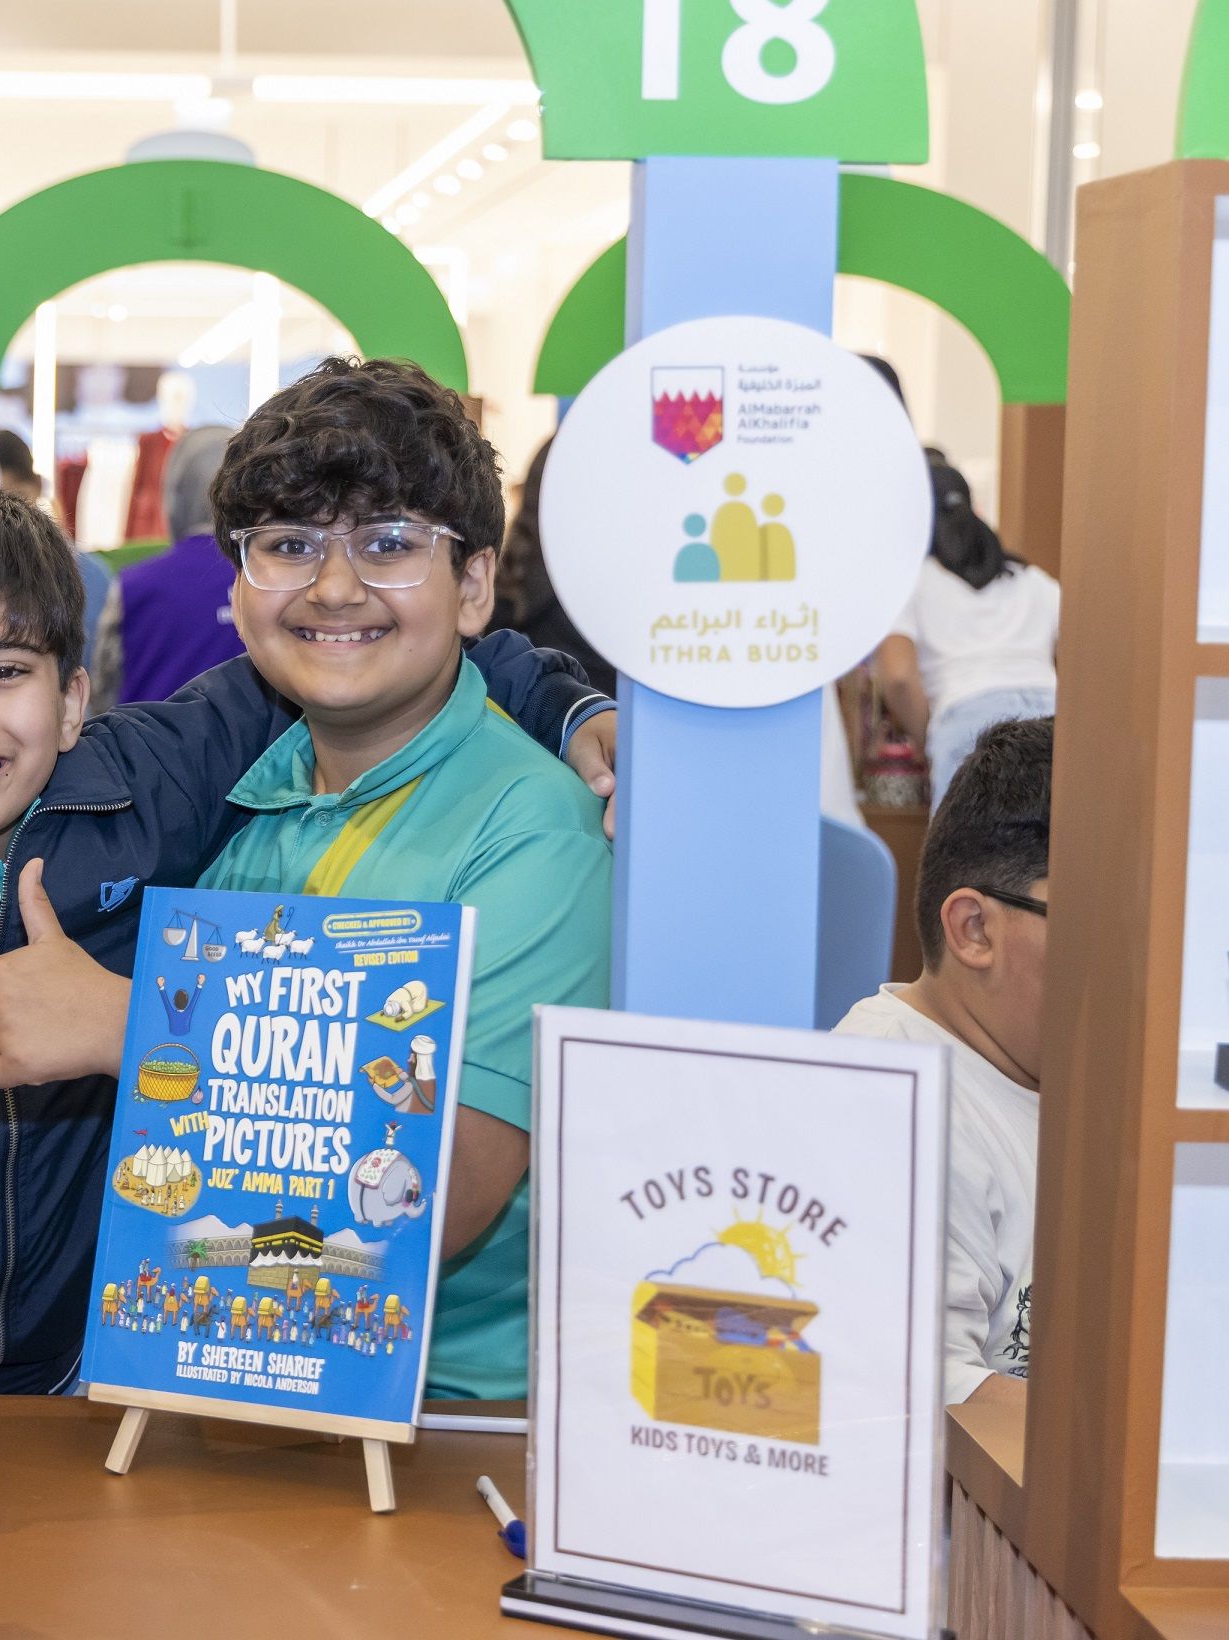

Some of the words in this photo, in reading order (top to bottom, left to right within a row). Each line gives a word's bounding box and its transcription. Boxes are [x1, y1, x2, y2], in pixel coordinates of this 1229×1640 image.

[641, 0, 836, 104] 18
[738, 403, 821, 415] AlMabarrah
[737, 434, 793, 444] Foundation
[650, 608, 741, 639] البراعم
[650, 643, 731, 663] ITHRA
[748, 643, 820, 662] BUDS
[332, 919, 362, 930] CHECKED
[354, 952, 386, 967] REVISED
[387, 950, 419, 965] EDITION
[225, 971, 265, 1007] MY
[268, 966, 367, 1018] FIRST
[211, 1012, 359, 1086] QURAN
[208, 1079, 355, 1124] TRANSLATION
[170, 1111, 210, 1137] WITH
[202, 1115, 351, 1175] PICTURES
[242, 1171, 283, 1194] AMMA
[288, 1176, 324, 1199] PART
[327, 1179, 335, 1200] 1
[620, 1165, 713, 1221] TOYS
[731, 1167, 848, 1247] STORE
[177, 1341, 196, 1364] BY
[201, 1344, 262, 1374] SHEREEN
[268, 1353, 326, 1380] SHARIEF
[176, 1364, 227, 1383] ILLUSTRATED
[230, 1371, 241, 1384] BY
[244, 1371, 272, 1388] NICOLA
[274, 1375, 319, 1395] ANDERSON
[631, 1425, 678, 1451] KIDS
[684, 1432, 738, 1462] TOYS
[743, 1444, 762, 1465] &
[767, 1447, 829, 1477] MORE
